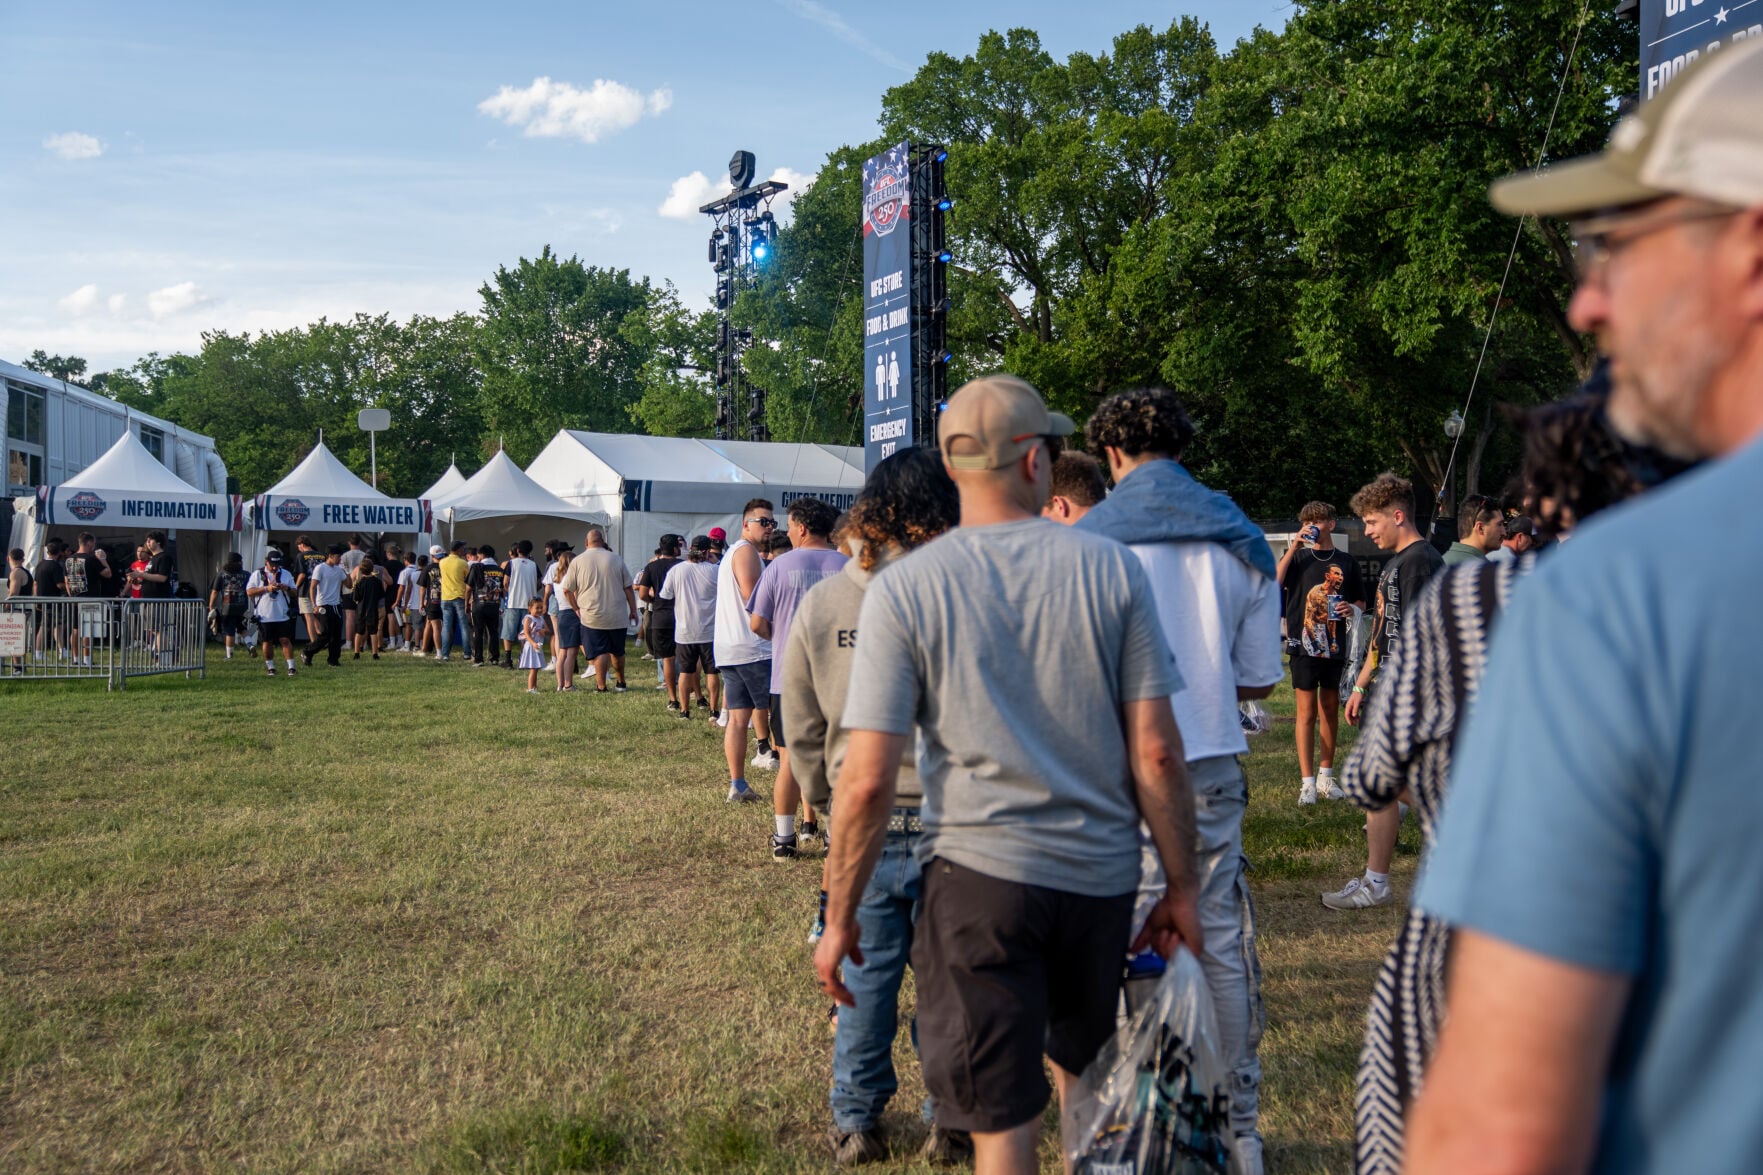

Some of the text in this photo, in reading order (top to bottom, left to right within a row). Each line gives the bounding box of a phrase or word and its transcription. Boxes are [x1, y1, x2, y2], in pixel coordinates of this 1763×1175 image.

[867, 178, 906, 213] FREEDOM
[878, 201, 894, 222] 250
[870, 270, 903, 298] UFC STORE
[866, 306, 908, 337] FOOD & DRINK
[870, 418, 907, 443] EMERGENCY
[881, 441, 896, 460] EXIT
[66, 500, 107, 511] FREEDOM
[79, 507, 96, 516] 250
[122, 500, 217, 520] INFORMATION
[323, 504, 414, 525] FREE WATER
[286, 514, 301, 522] 250
